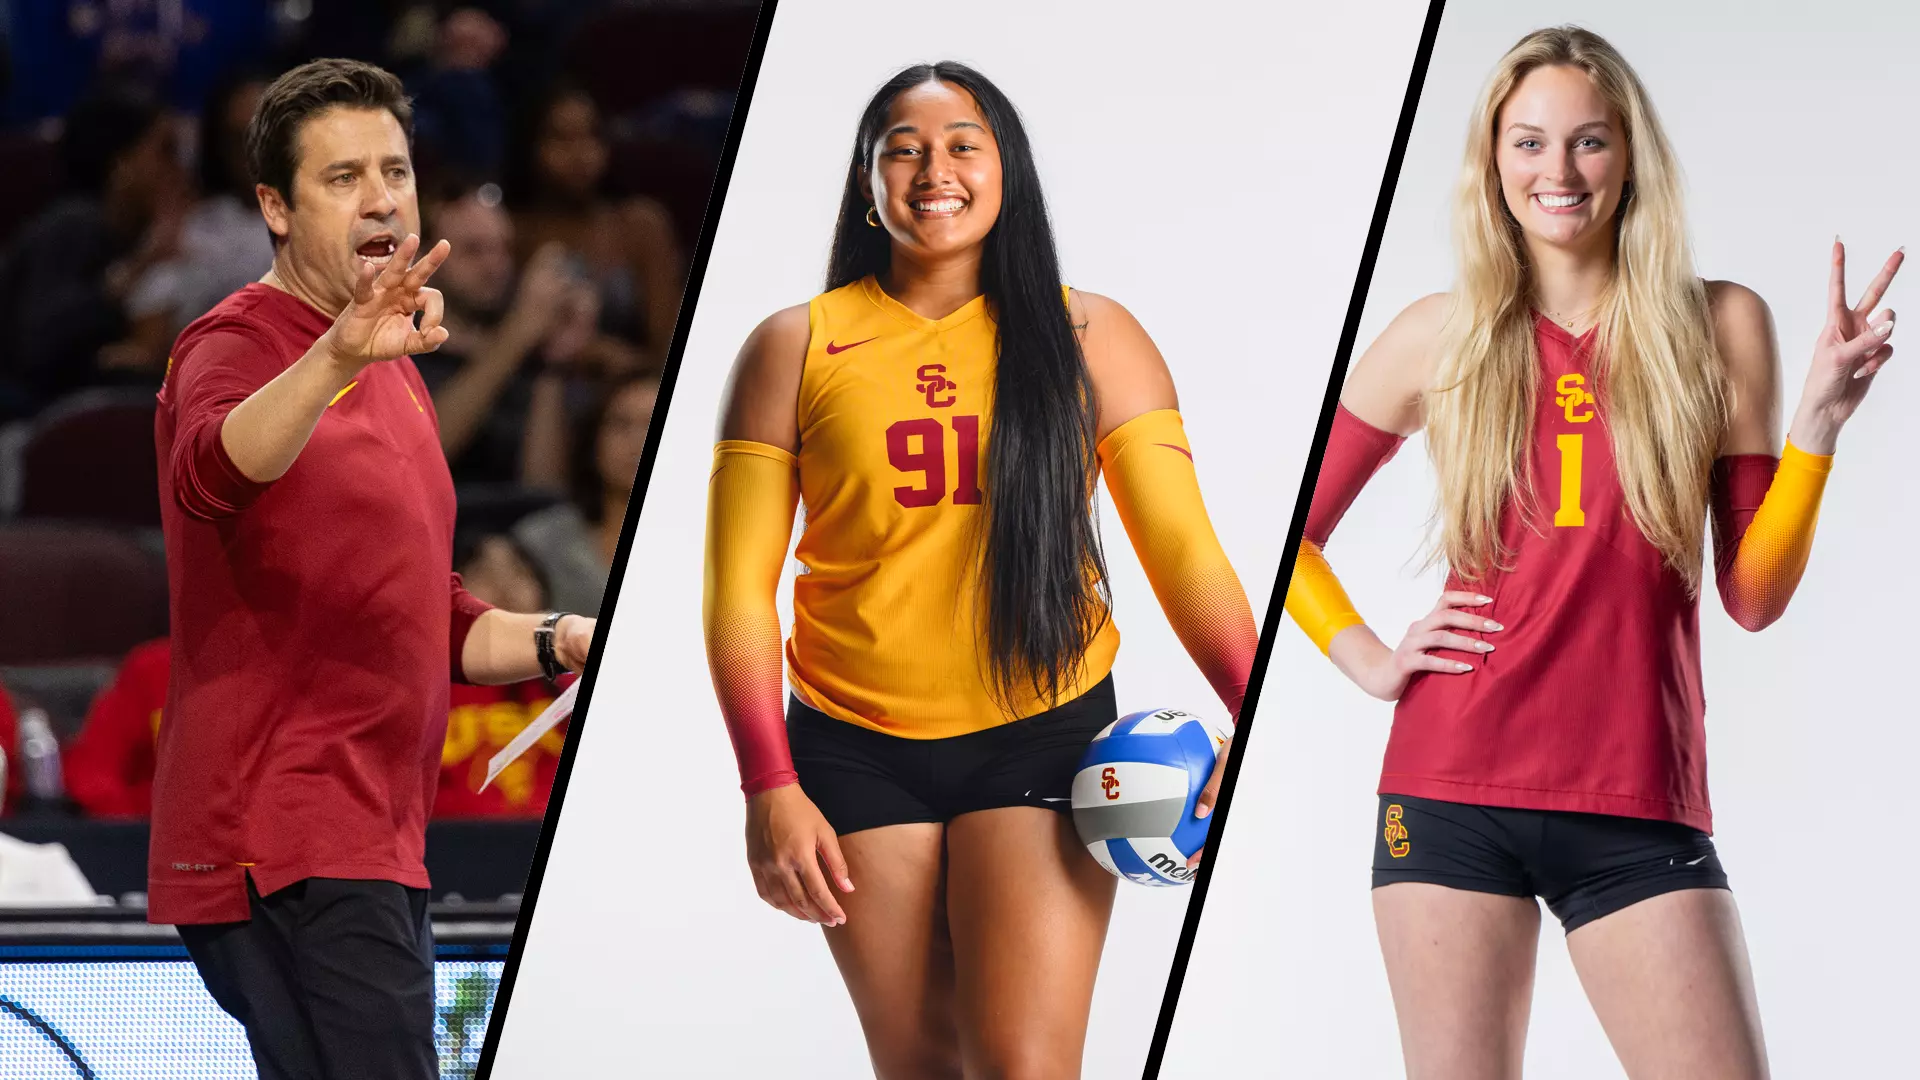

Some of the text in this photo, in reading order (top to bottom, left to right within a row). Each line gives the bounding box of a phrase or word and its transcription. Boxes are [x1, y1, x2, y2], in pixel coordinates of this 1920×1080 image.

[916, 364, 956, 408] SC
[1556, 373, 1595, 423] SC
[886, 415, 982, 508] 91
[1554, 433, 1585, 527] 1
[1101, 767, 1120, 800] SC
[1384, 804, 1410, 858] SC
